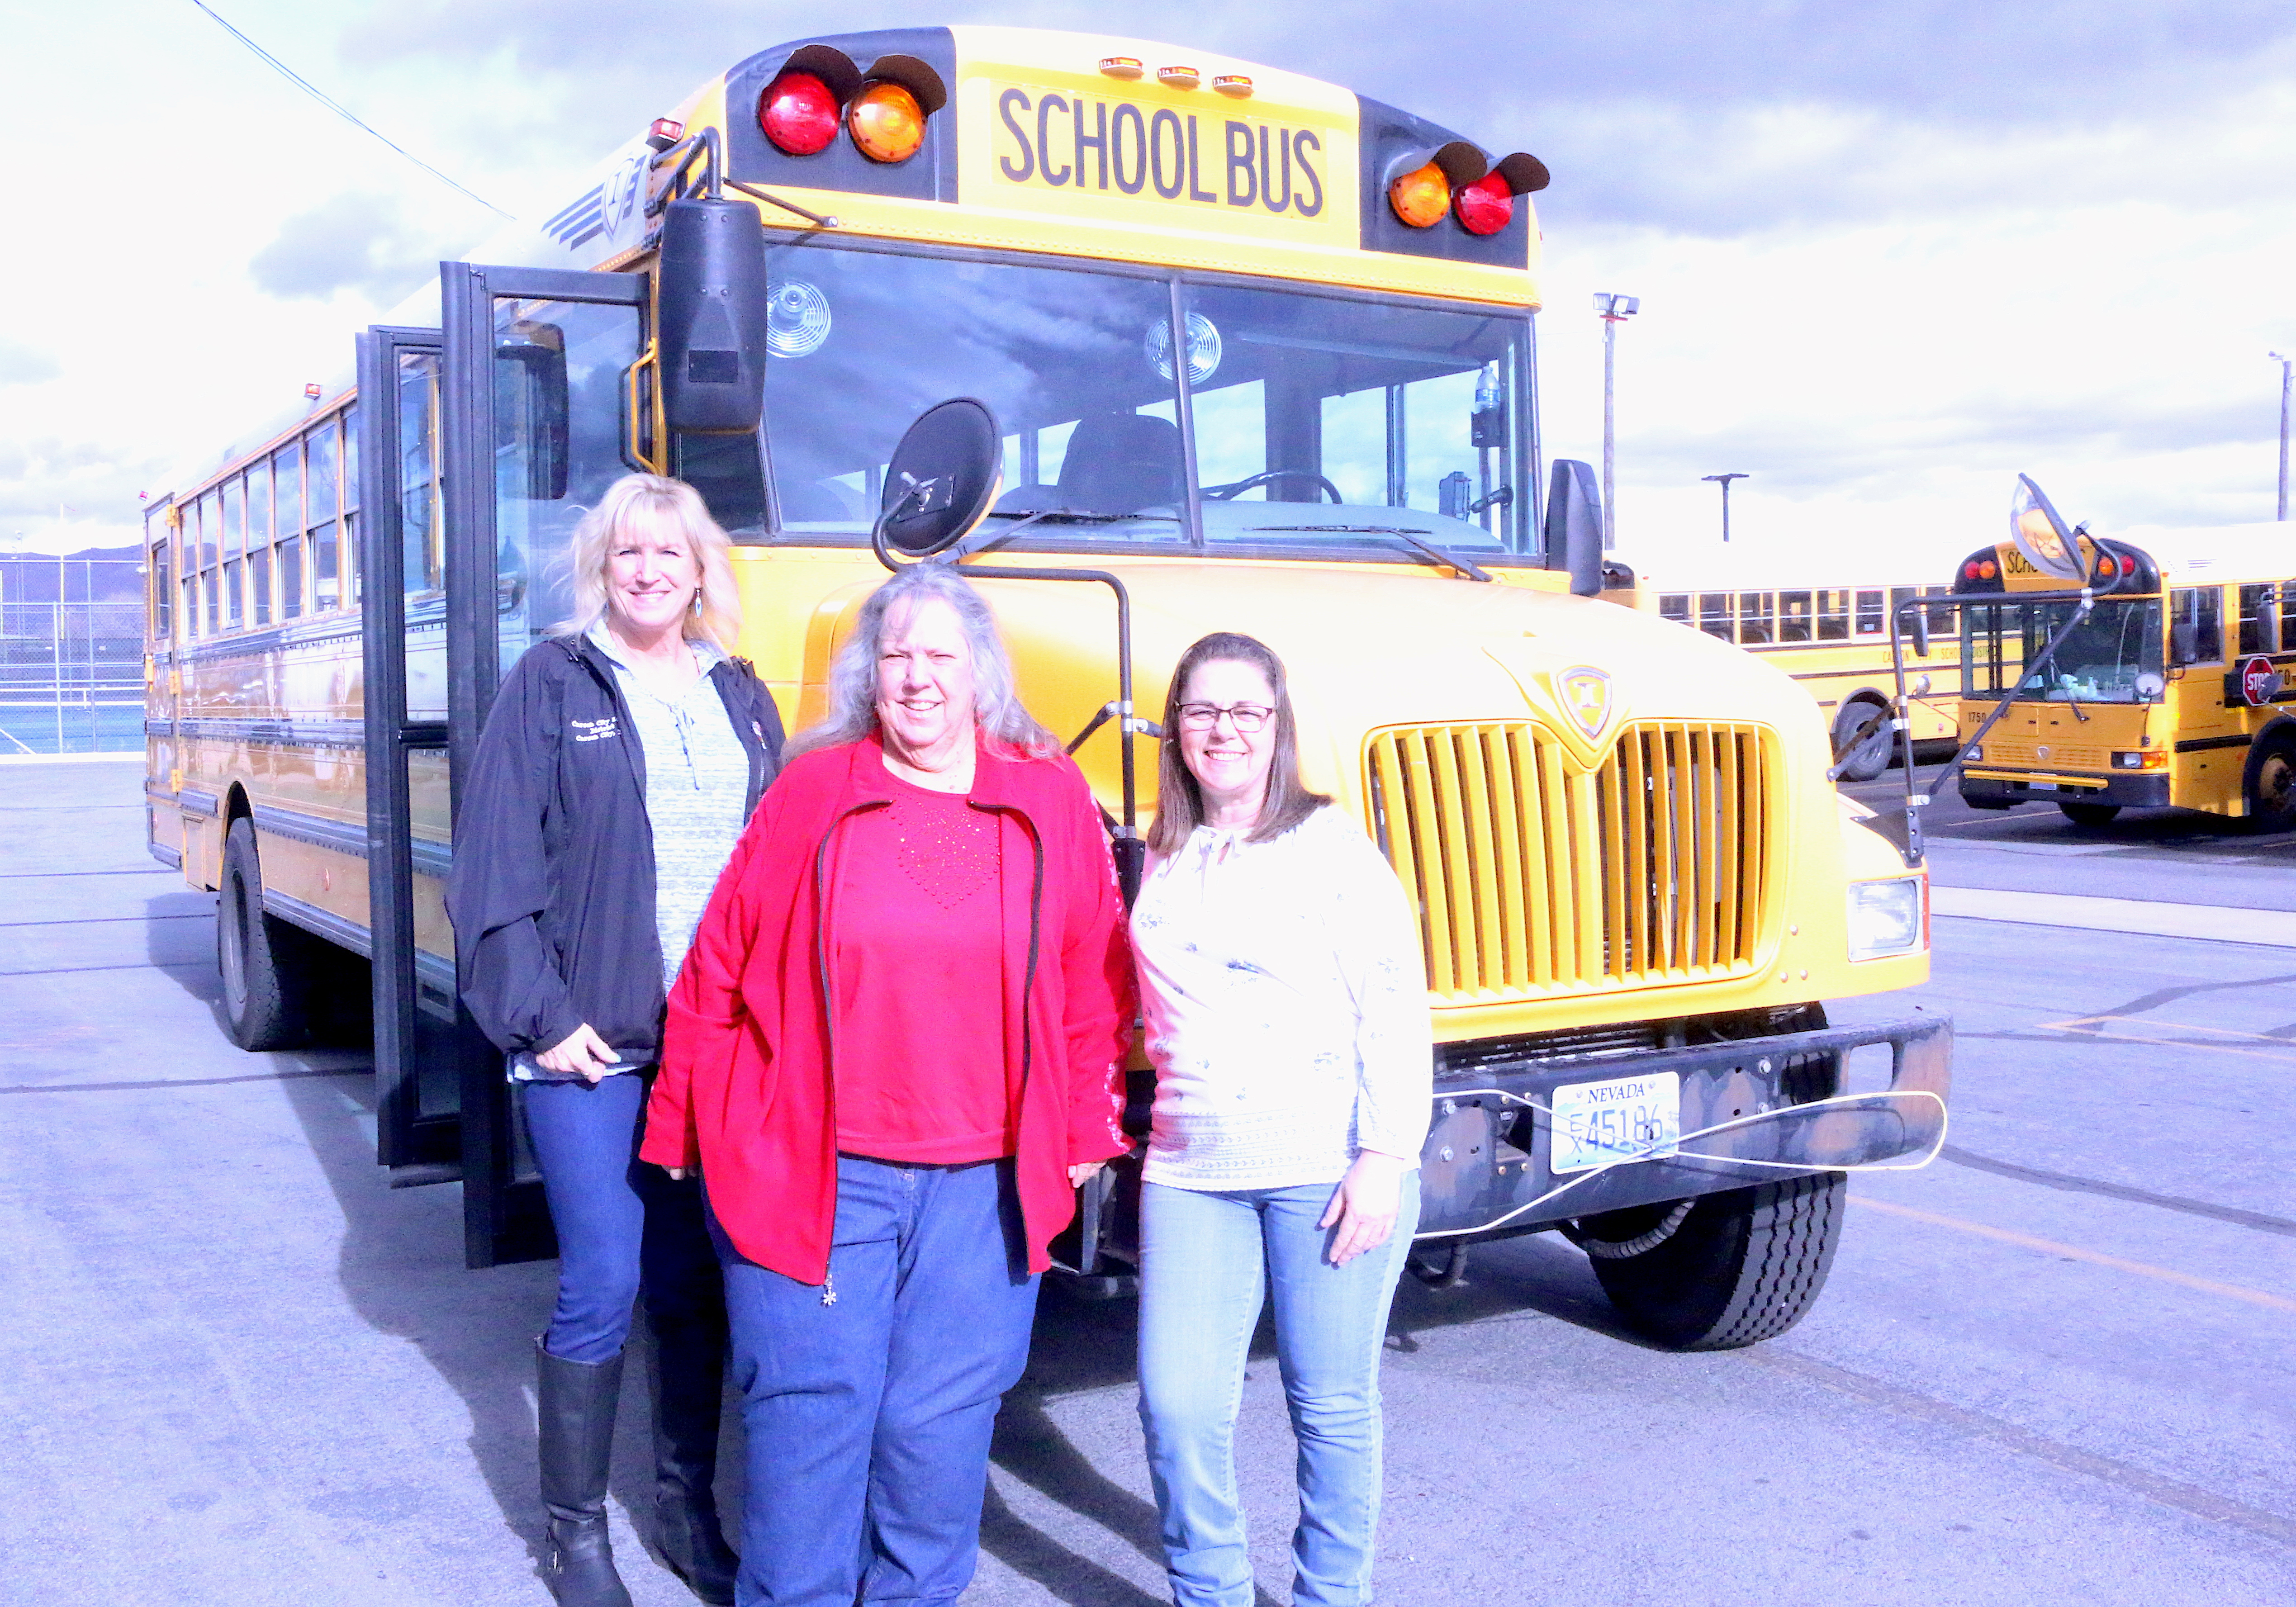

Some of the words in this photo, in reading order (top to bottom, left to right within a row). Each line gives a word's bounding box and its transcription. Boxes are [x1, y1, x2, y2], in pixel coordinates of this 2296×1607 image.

[998, 88, 1217, 204] SCHOOL
[1225, 120, 1324, 218] BUS
[1969, 712, 1986, 723] 1750
[1588, 1082, 1645, 1104] NEVADA
[1586, 1104, 1663, 1151] 45186
